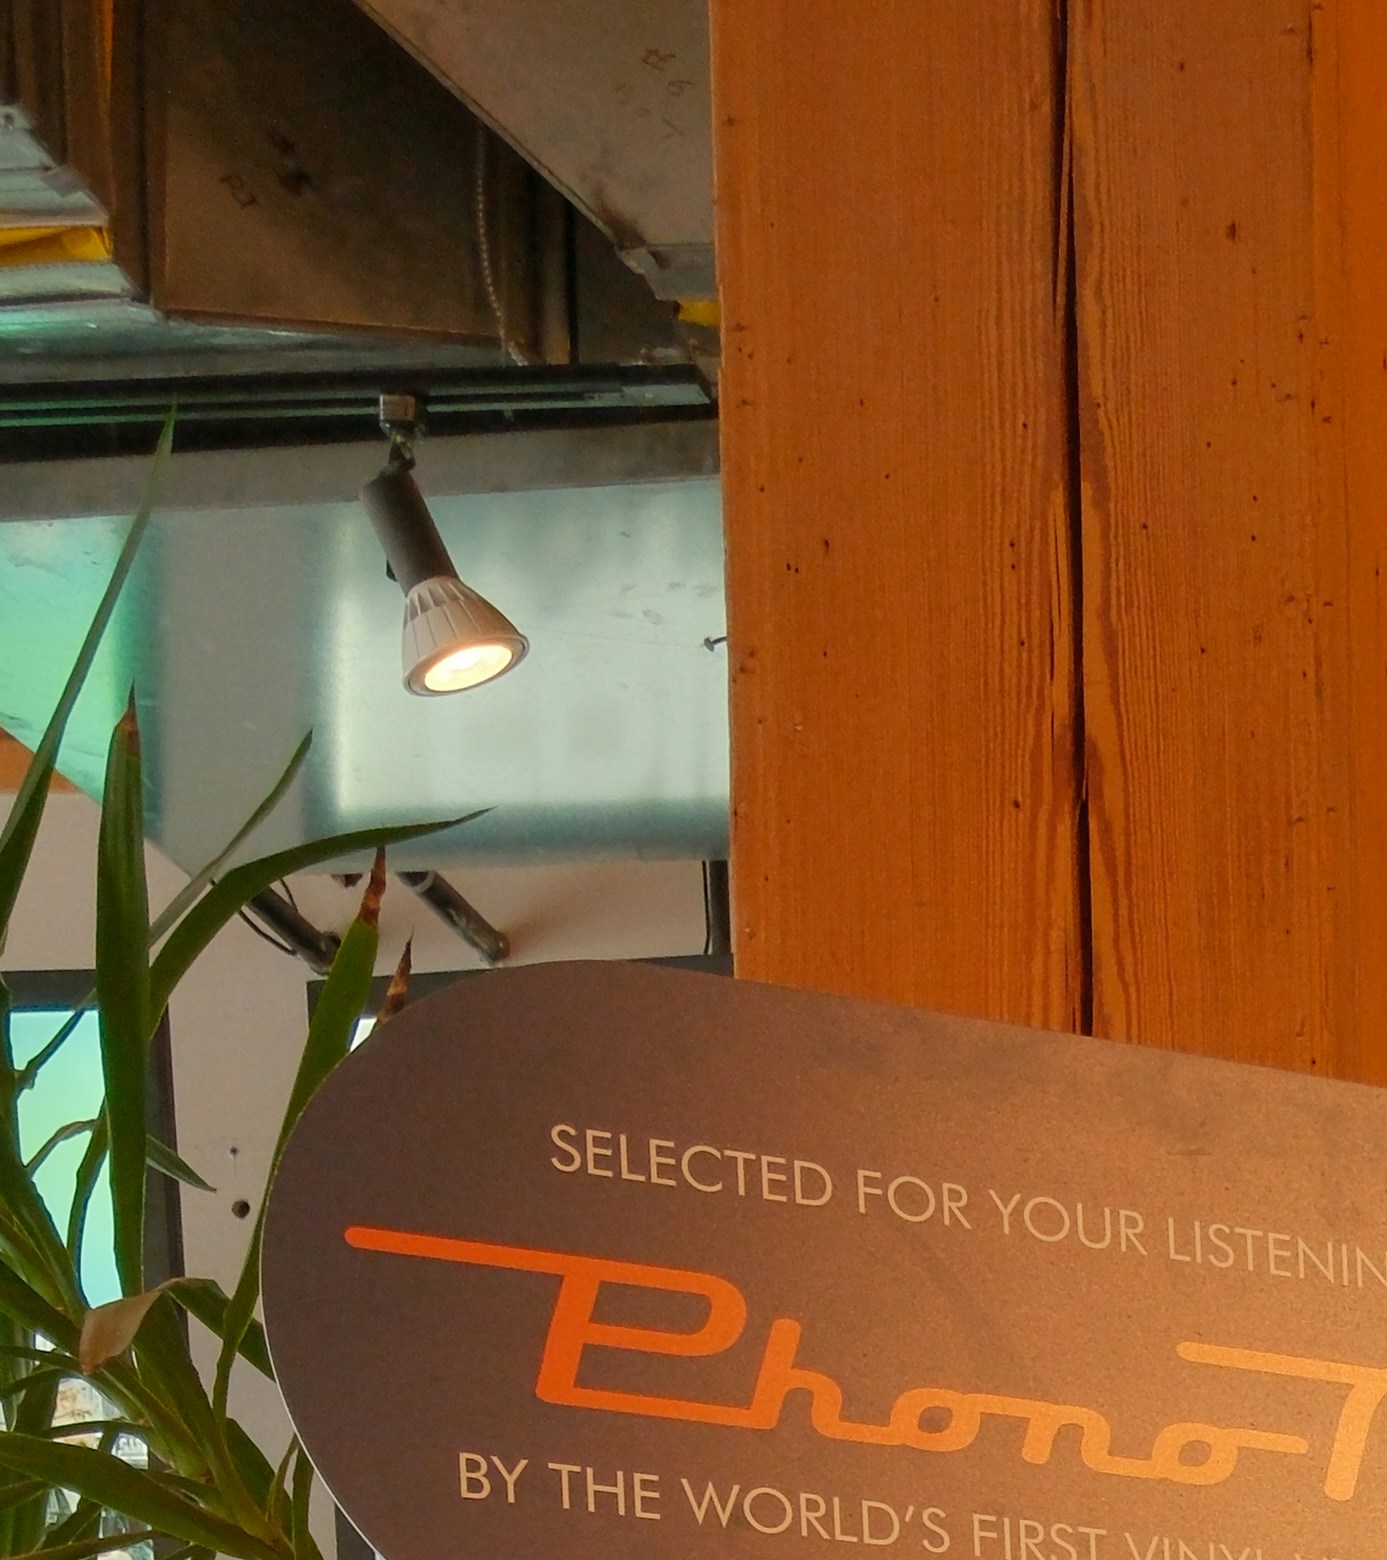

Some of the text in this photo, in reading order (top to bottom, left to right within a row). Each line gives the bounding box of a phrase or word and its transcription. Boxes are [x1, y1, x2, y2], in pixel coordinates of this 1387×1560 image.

[550, 1124, 832, 1206] SELECTED
[857, 1169, 971, 1229] FOR
[989, 1190, 1148, 1255] YOUR
[459, 1452, 528, 1504] BY
[549, 1462, 661, 1520] THE
[681, 1477, 950, 1553] WORLD'S
